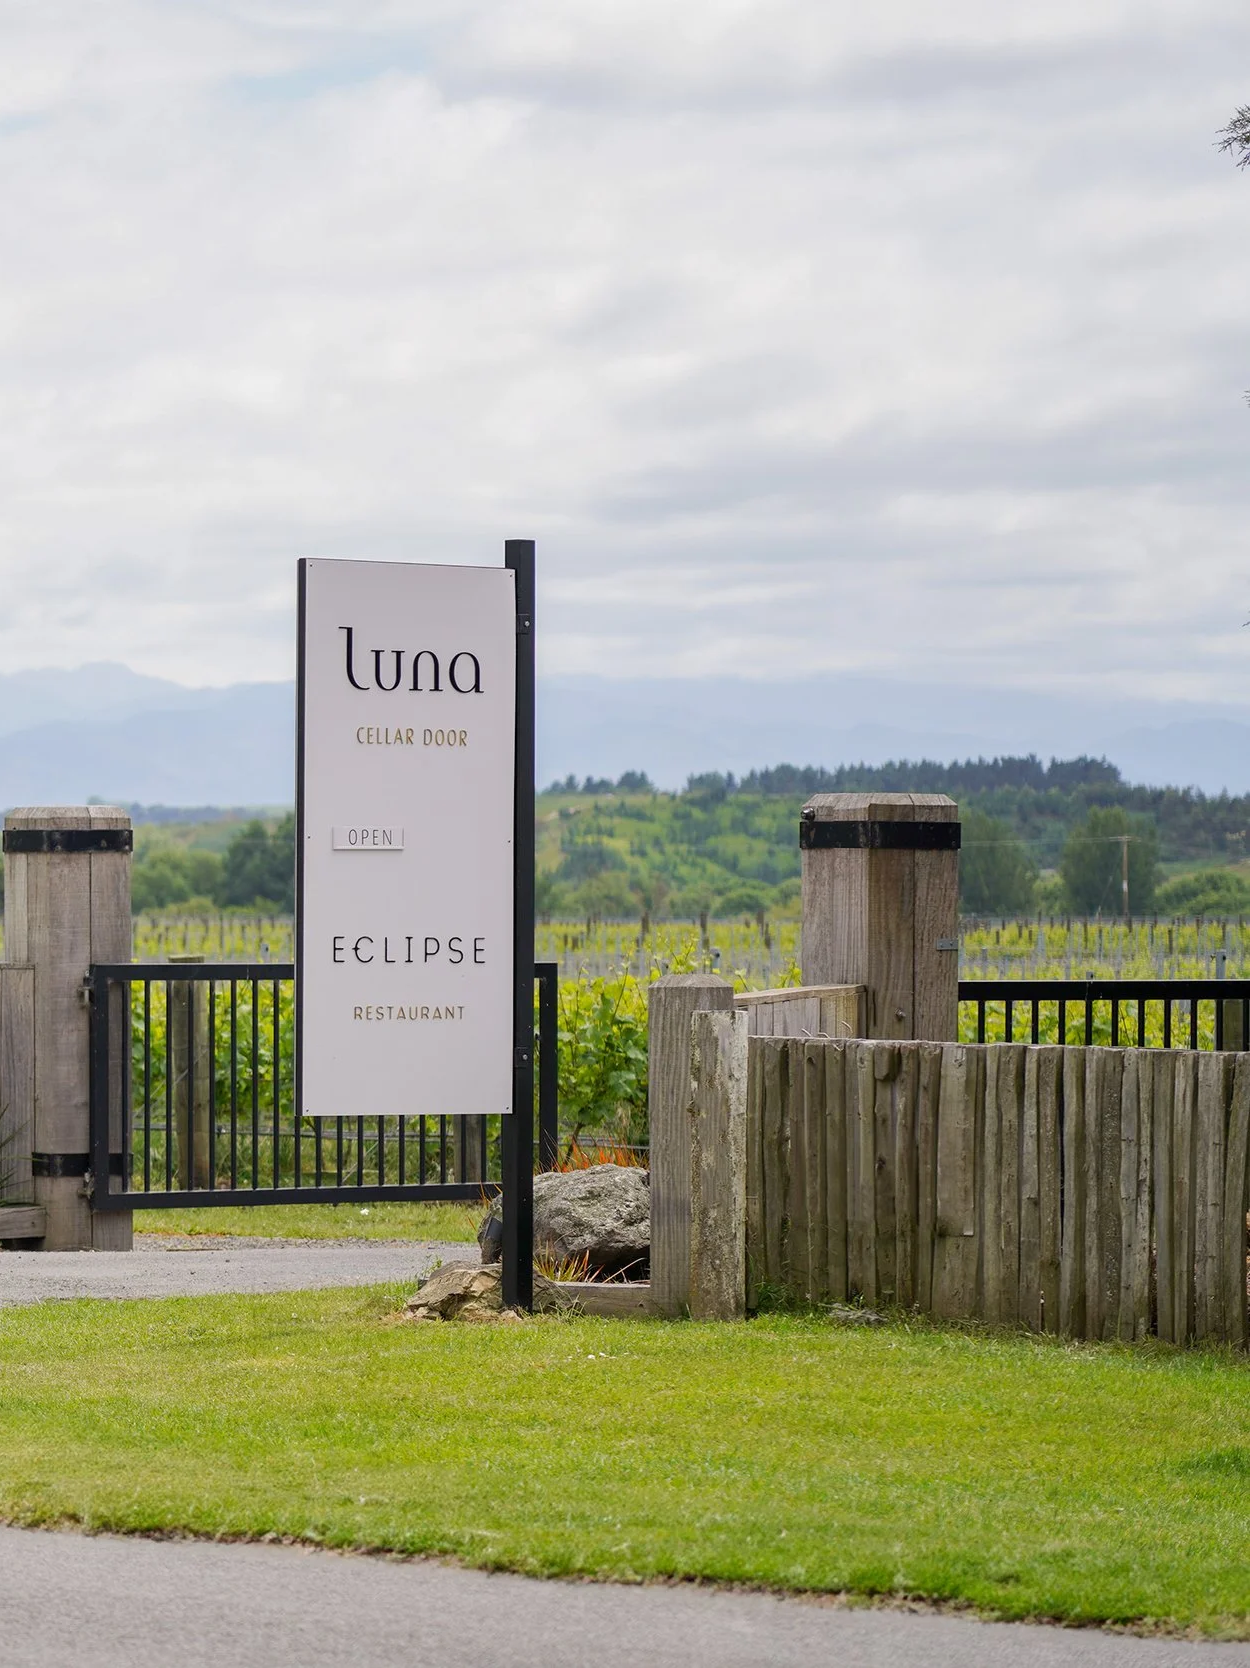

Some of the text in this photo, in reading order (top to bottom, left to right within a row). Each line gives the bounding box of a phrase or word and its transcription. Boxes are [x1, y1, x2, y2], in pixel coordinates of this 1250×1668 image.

[337, 626, 485, 694] luna
[356, 726, 469, 748] CELLAR DOOR
[347, 828, 394, 846] OPEN
[332, 935, 486, 964] ECLIPSE
[353, 1005, 466, 1021] RESTAURANT
